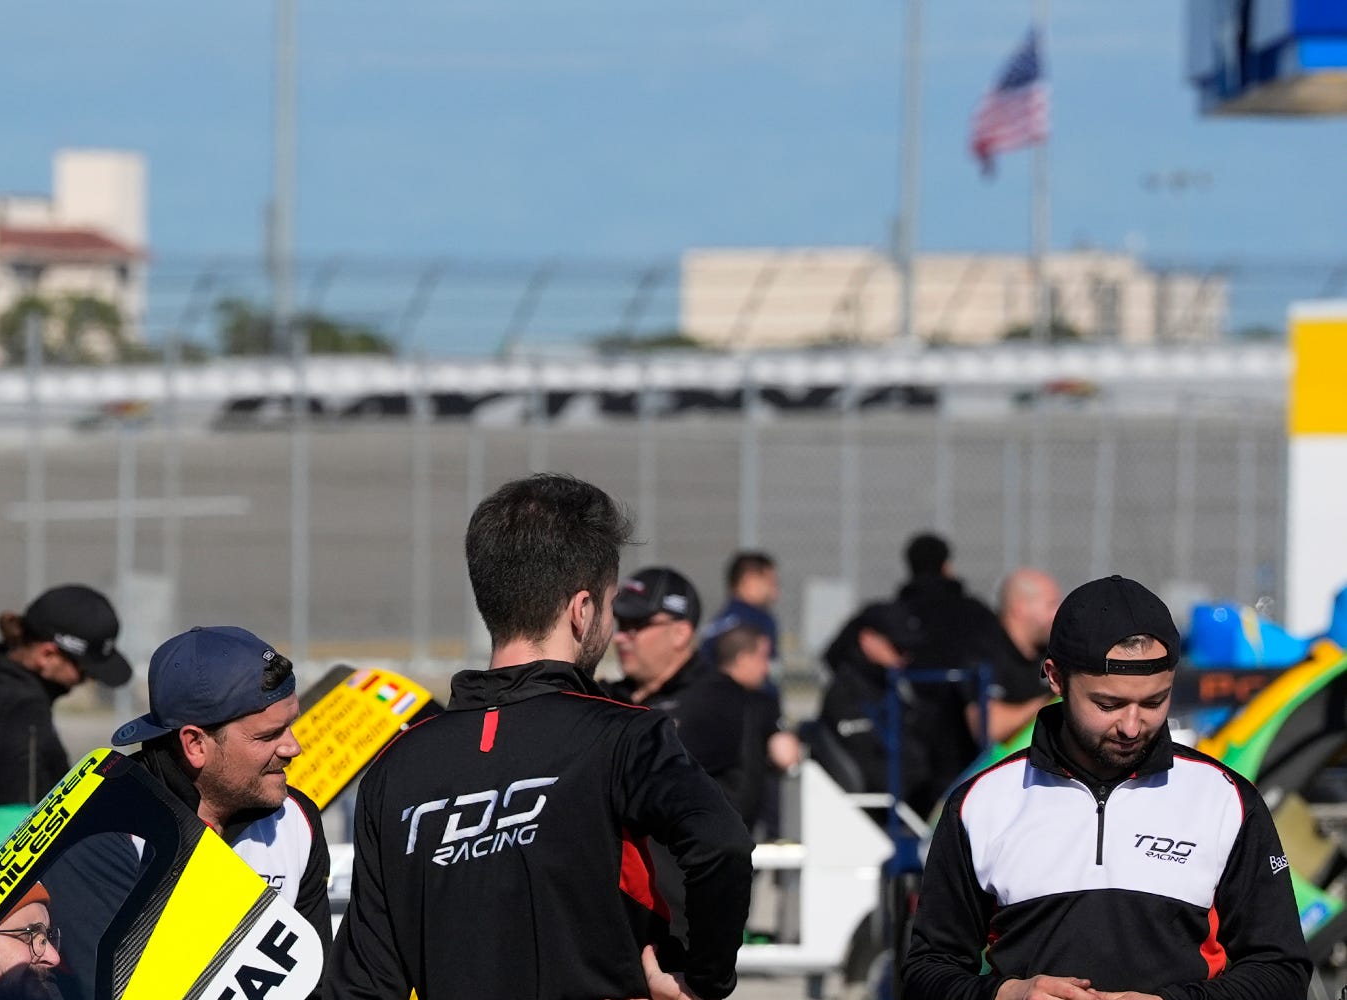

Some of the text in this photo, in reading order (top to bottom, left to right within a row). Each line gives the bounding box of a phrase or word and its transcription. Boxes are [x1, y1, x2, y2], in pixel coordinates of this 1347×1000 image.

[401, 776, 559, 855] TDS
[432, 823, 540, 866] RACING
[1134, 833, 1197, 858] TDS
[1145, 850, 1188, 865] RACING
